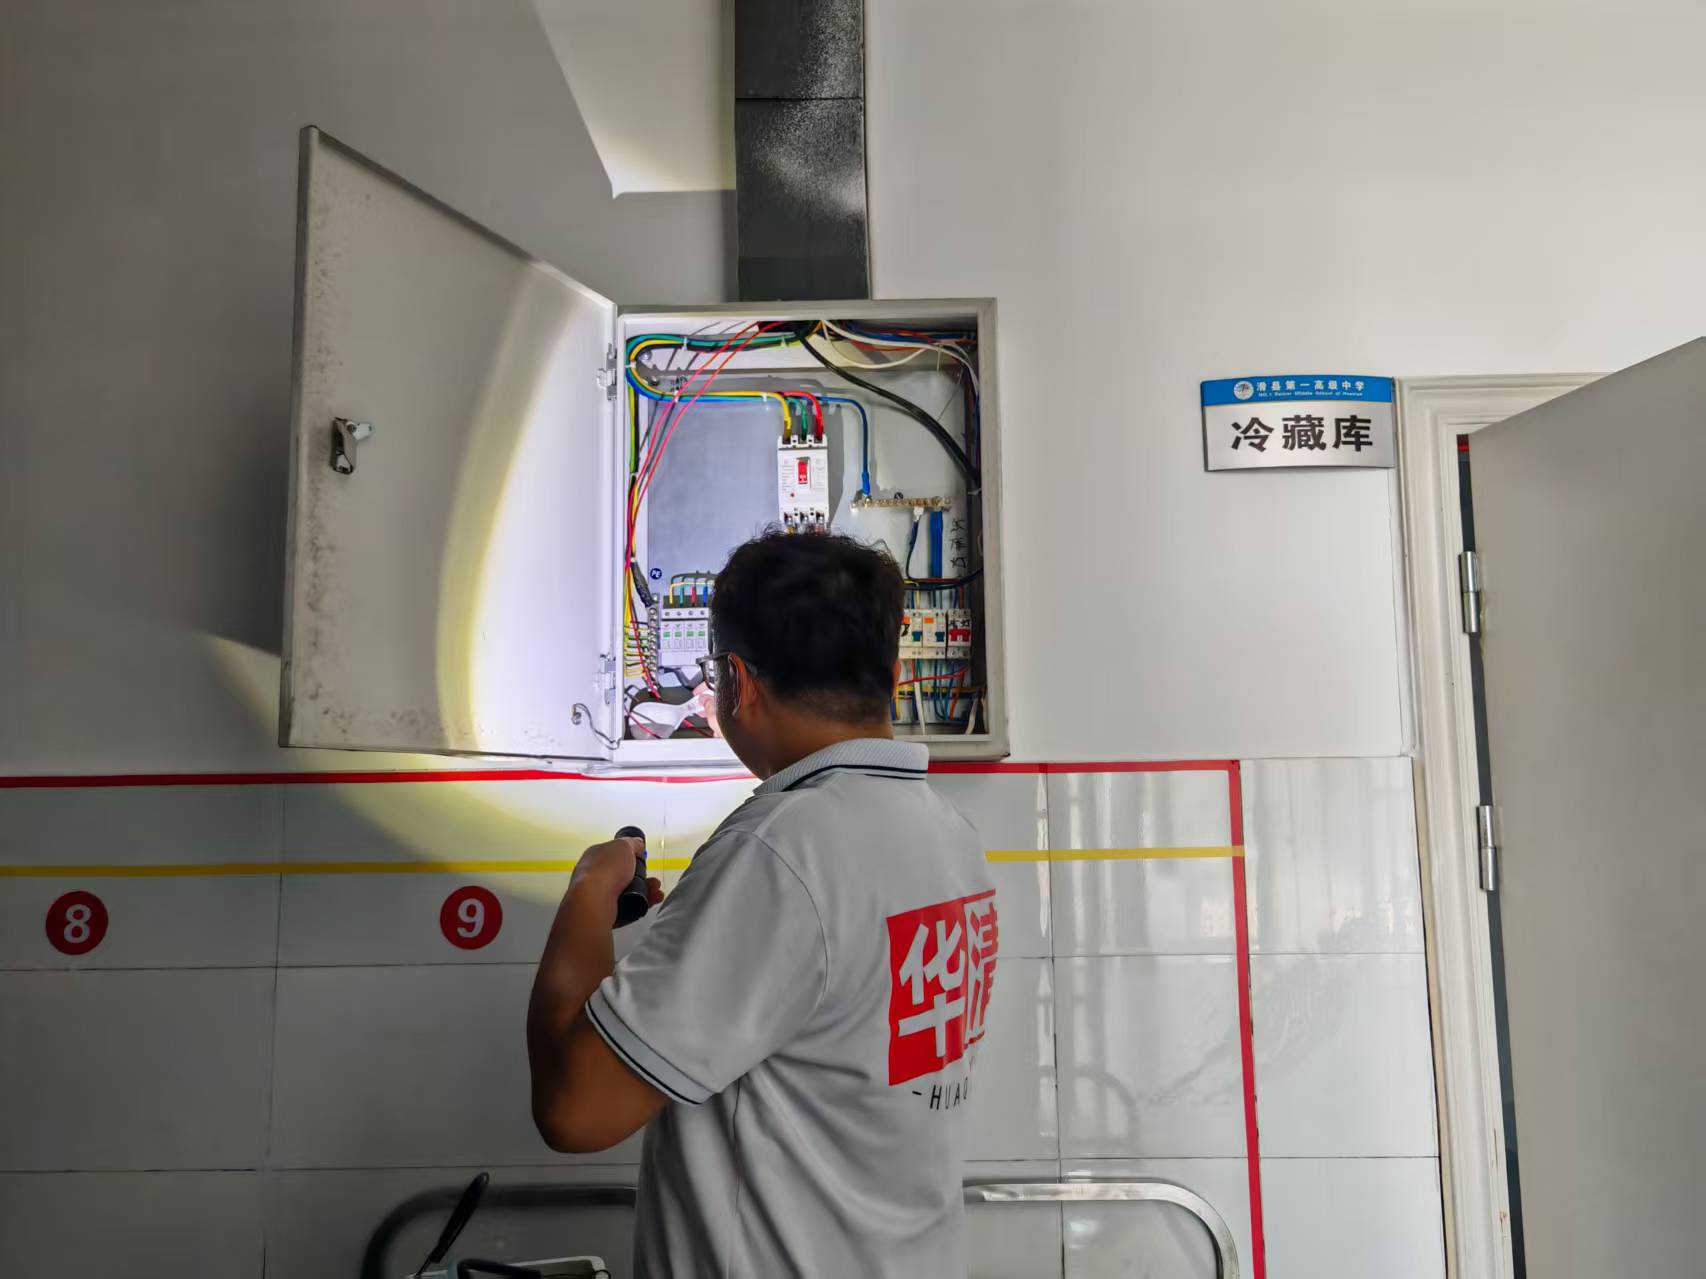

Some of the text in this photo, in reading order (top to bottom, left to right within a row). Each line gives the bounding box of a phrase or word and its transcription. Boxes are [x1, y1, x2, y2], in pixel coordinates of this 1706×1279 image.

[1231, 414, 1374, 453] 冷藏库
[63, 903, 92, 943] 8
[457, 898, 485, 938] 9
